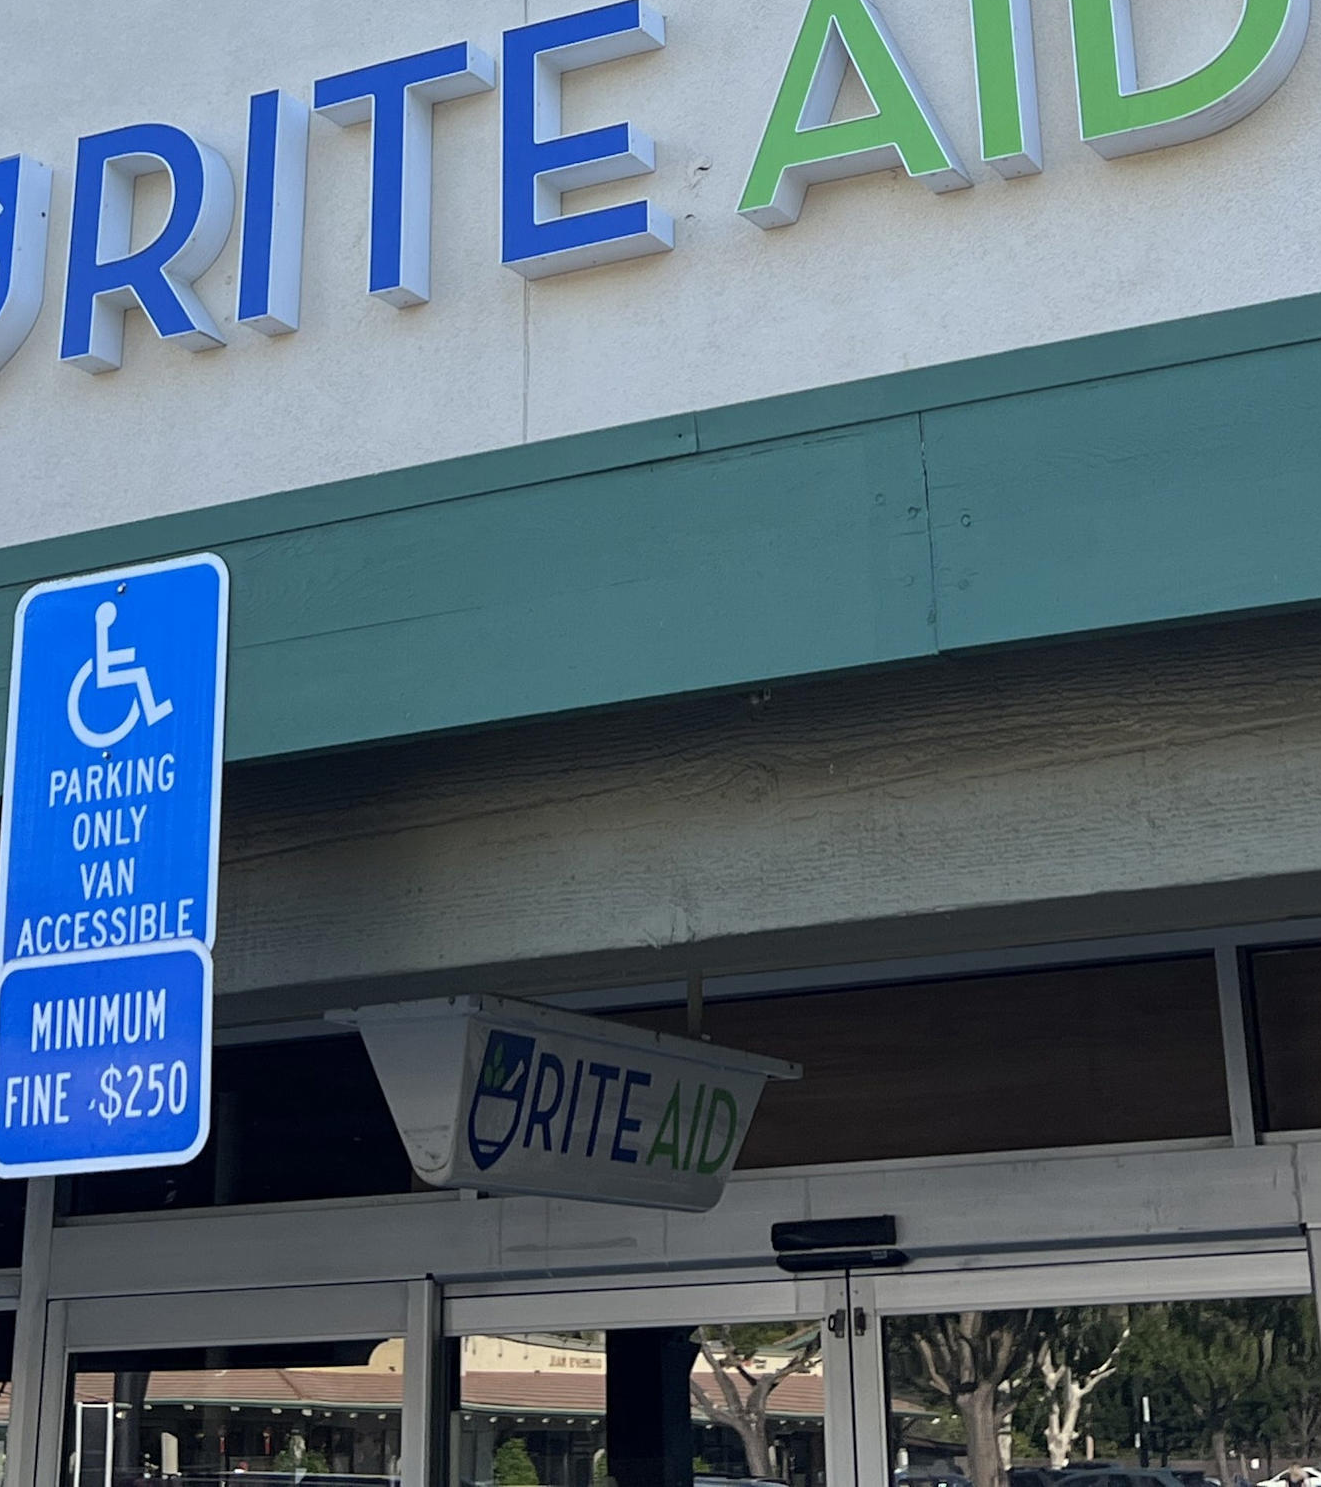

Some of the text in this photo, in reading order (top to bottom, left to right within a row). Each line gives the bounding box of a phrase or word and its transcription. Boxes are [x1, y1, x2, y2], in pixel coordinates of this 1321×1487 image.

[49, 753, 175, 808] PARKING
[72, 804, 148, 852] ONLY
[80, 857, 135, 901] VAN
[16, 897, 195, 957] ACCESSIBLE
[31, 988, 167, 1053] MINIMUM
[5, 1059, 188, 1129] FINE $250
[523, 1052, 738, 1175] RITE AID
